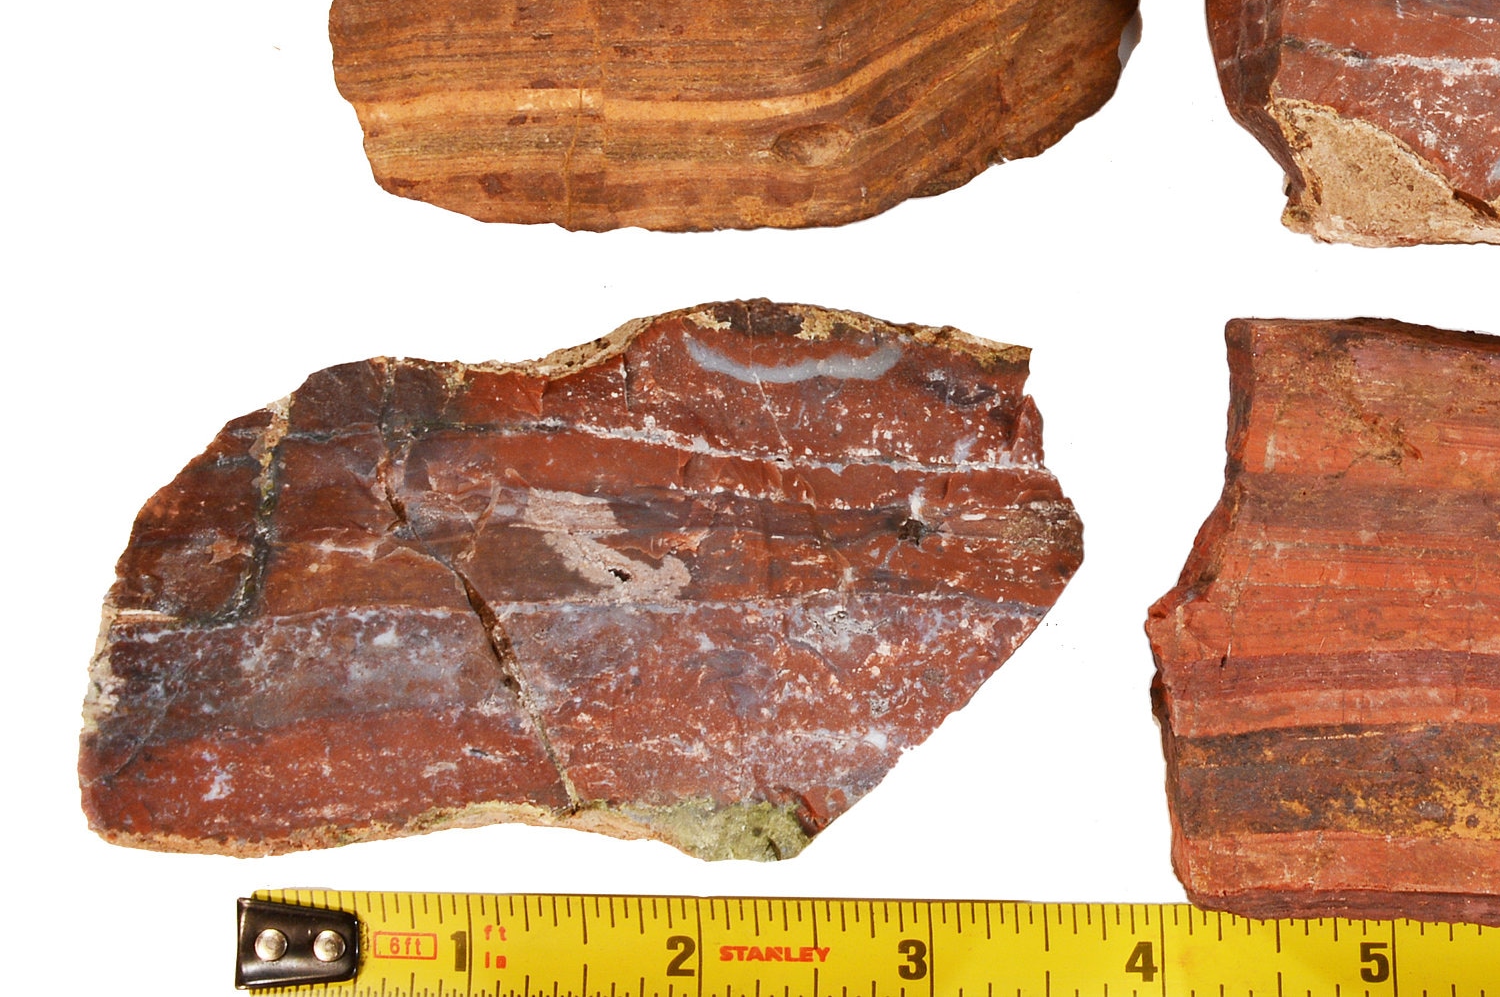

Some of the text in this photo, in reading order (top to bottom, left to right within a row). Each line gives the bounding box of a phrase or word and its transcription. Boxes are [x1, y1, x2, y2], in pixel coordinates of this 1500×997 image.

[389, 936, 422, 956] 6ft
[450, 930, 467, 972] 1
[483, 924, 507, 942] ft
[719, 945, 831, 963] STANLEY
[666, 935, 696, 977] 2
[897, 939, 928, 981] 3
[1124, 941, 1158, 983] 4
[1359, 942, 1390, 984] 5
